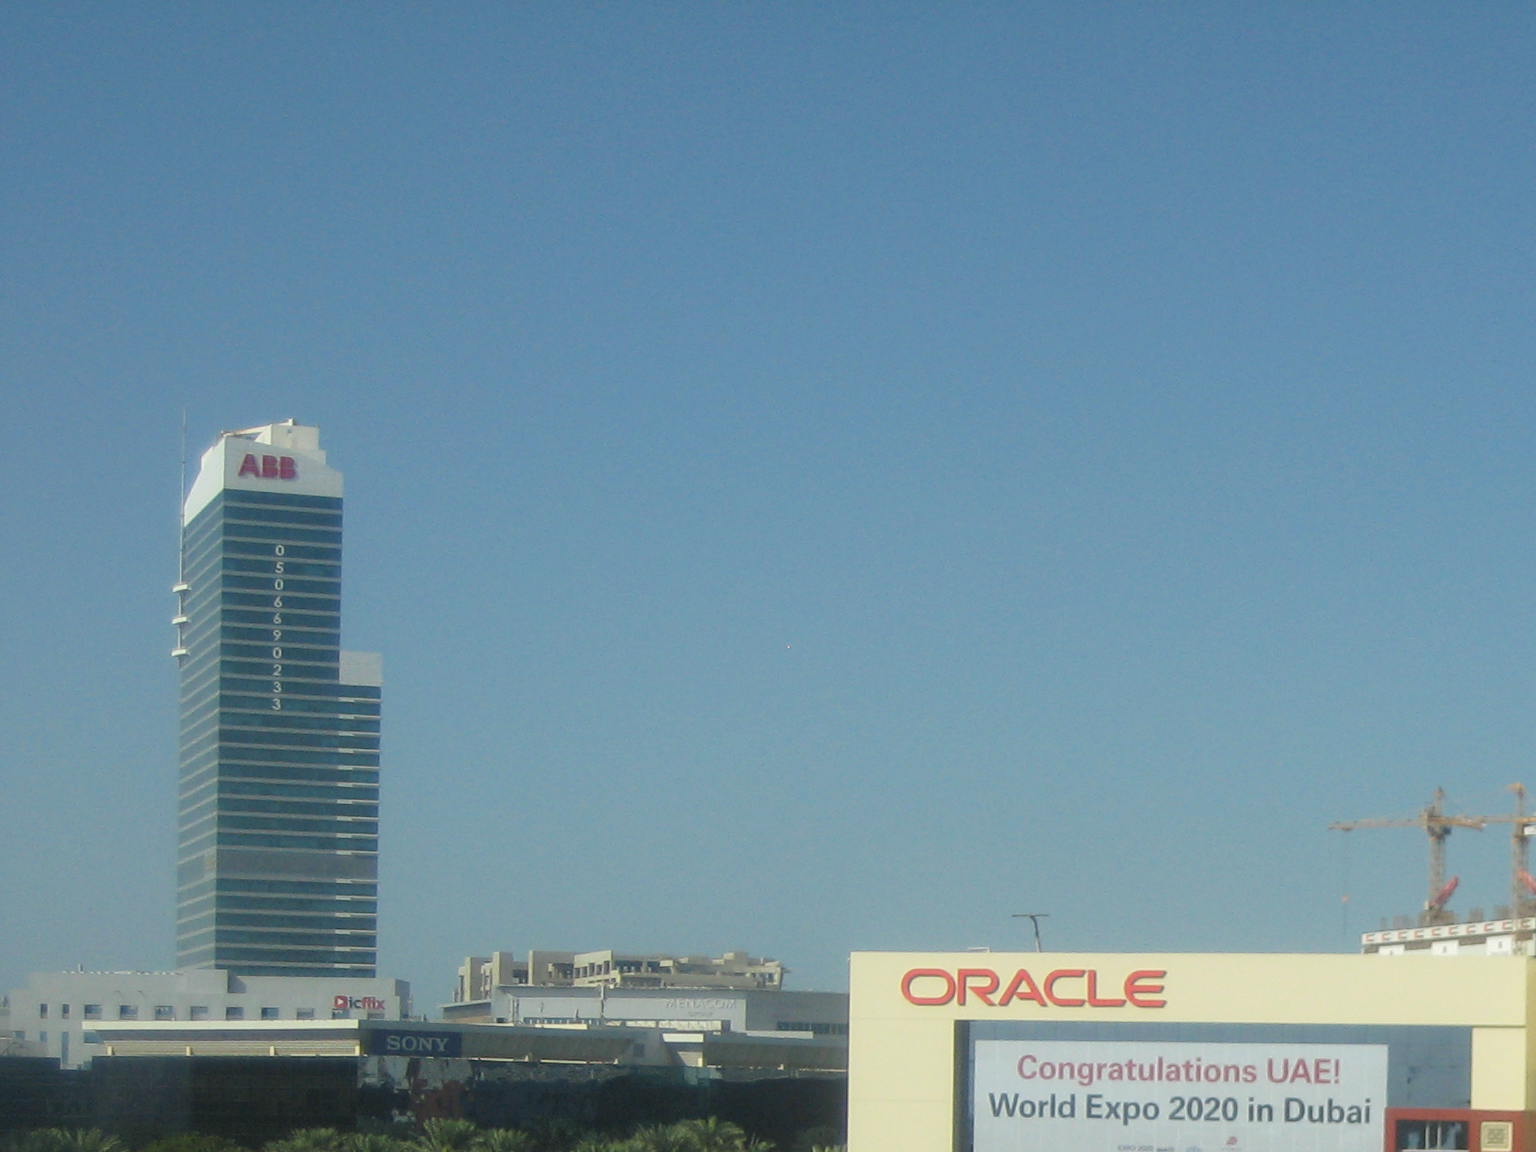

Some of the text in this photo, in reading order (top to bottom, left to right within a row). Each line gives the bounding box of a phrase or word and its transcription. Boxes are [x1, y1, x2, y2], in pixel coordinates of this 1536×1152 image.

[238, 453, 297, 480] ABB
[901, 968, 1168, 1008] ORACLE
[386, 1034, 450, 1052] SONY
[1016, 1054, 1341, 1086] Congratulations UAE!
[988, 1091, 1372, 1125] World Expo 2020 in Dubai
